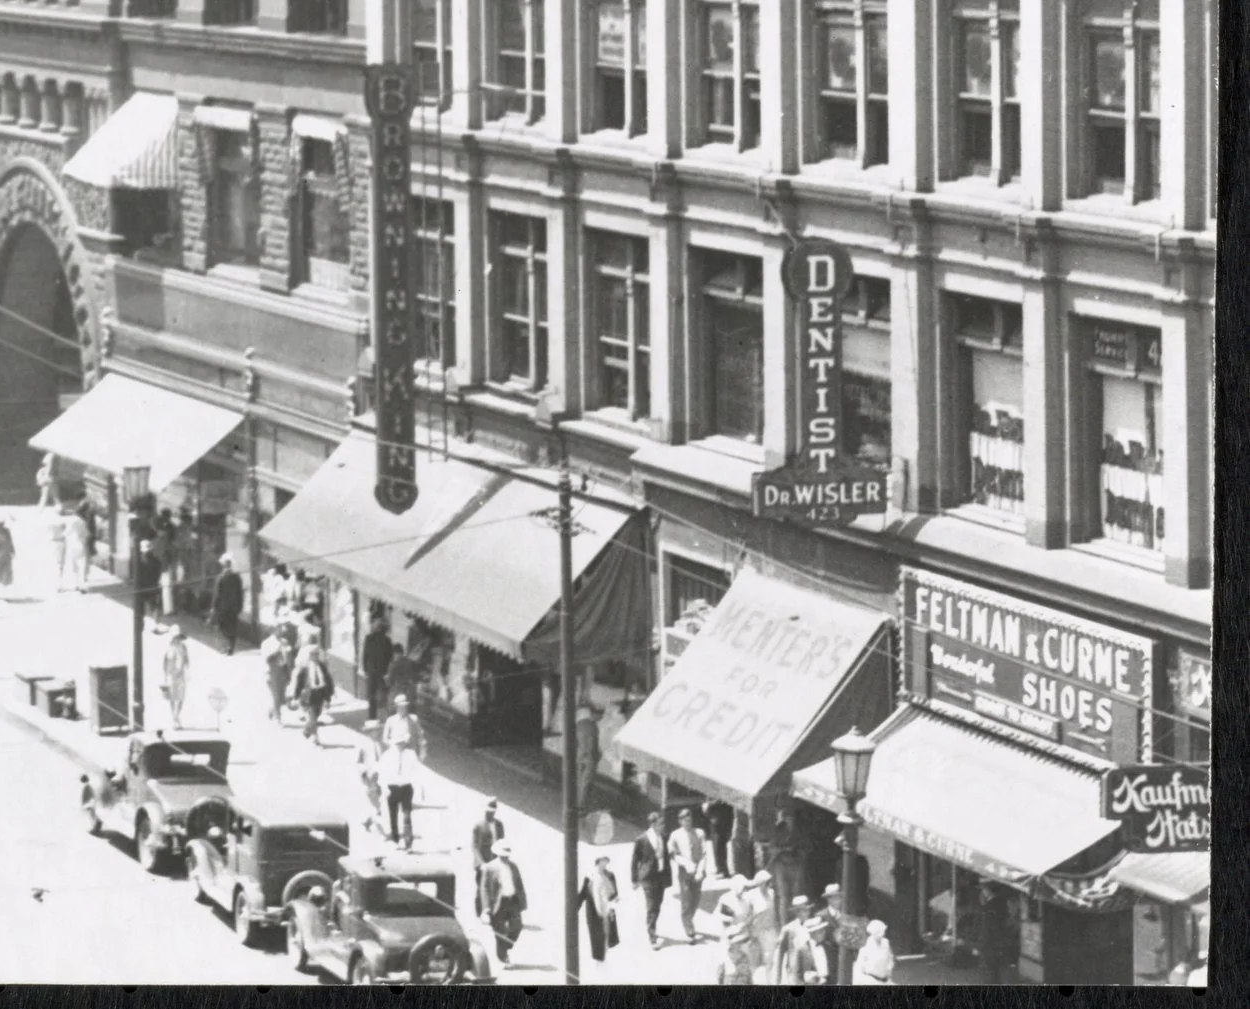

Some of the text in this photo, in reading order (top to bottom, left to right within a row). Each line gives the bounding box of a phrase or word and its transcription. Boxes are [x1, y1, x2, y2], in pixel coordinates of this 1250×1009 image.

[379, 74, 410, 505] BROWNING KING
[807, 254, 836, 473] DENTIST
[794, 480, 881, 505] WISLER
[806, 506, 841, 521] 423
[708, 600, 854, 680] MENTER'S
[915, 587, 1021, 657] FELTMAN
[1025, 633, 1041, 665] &
[1042, 628, 1131, 693] CURME
[652, 680, 796, 761] CREDIT
[725, 665, 779, 700] FOR
[1022, 672, 1113, 733] SHOES
